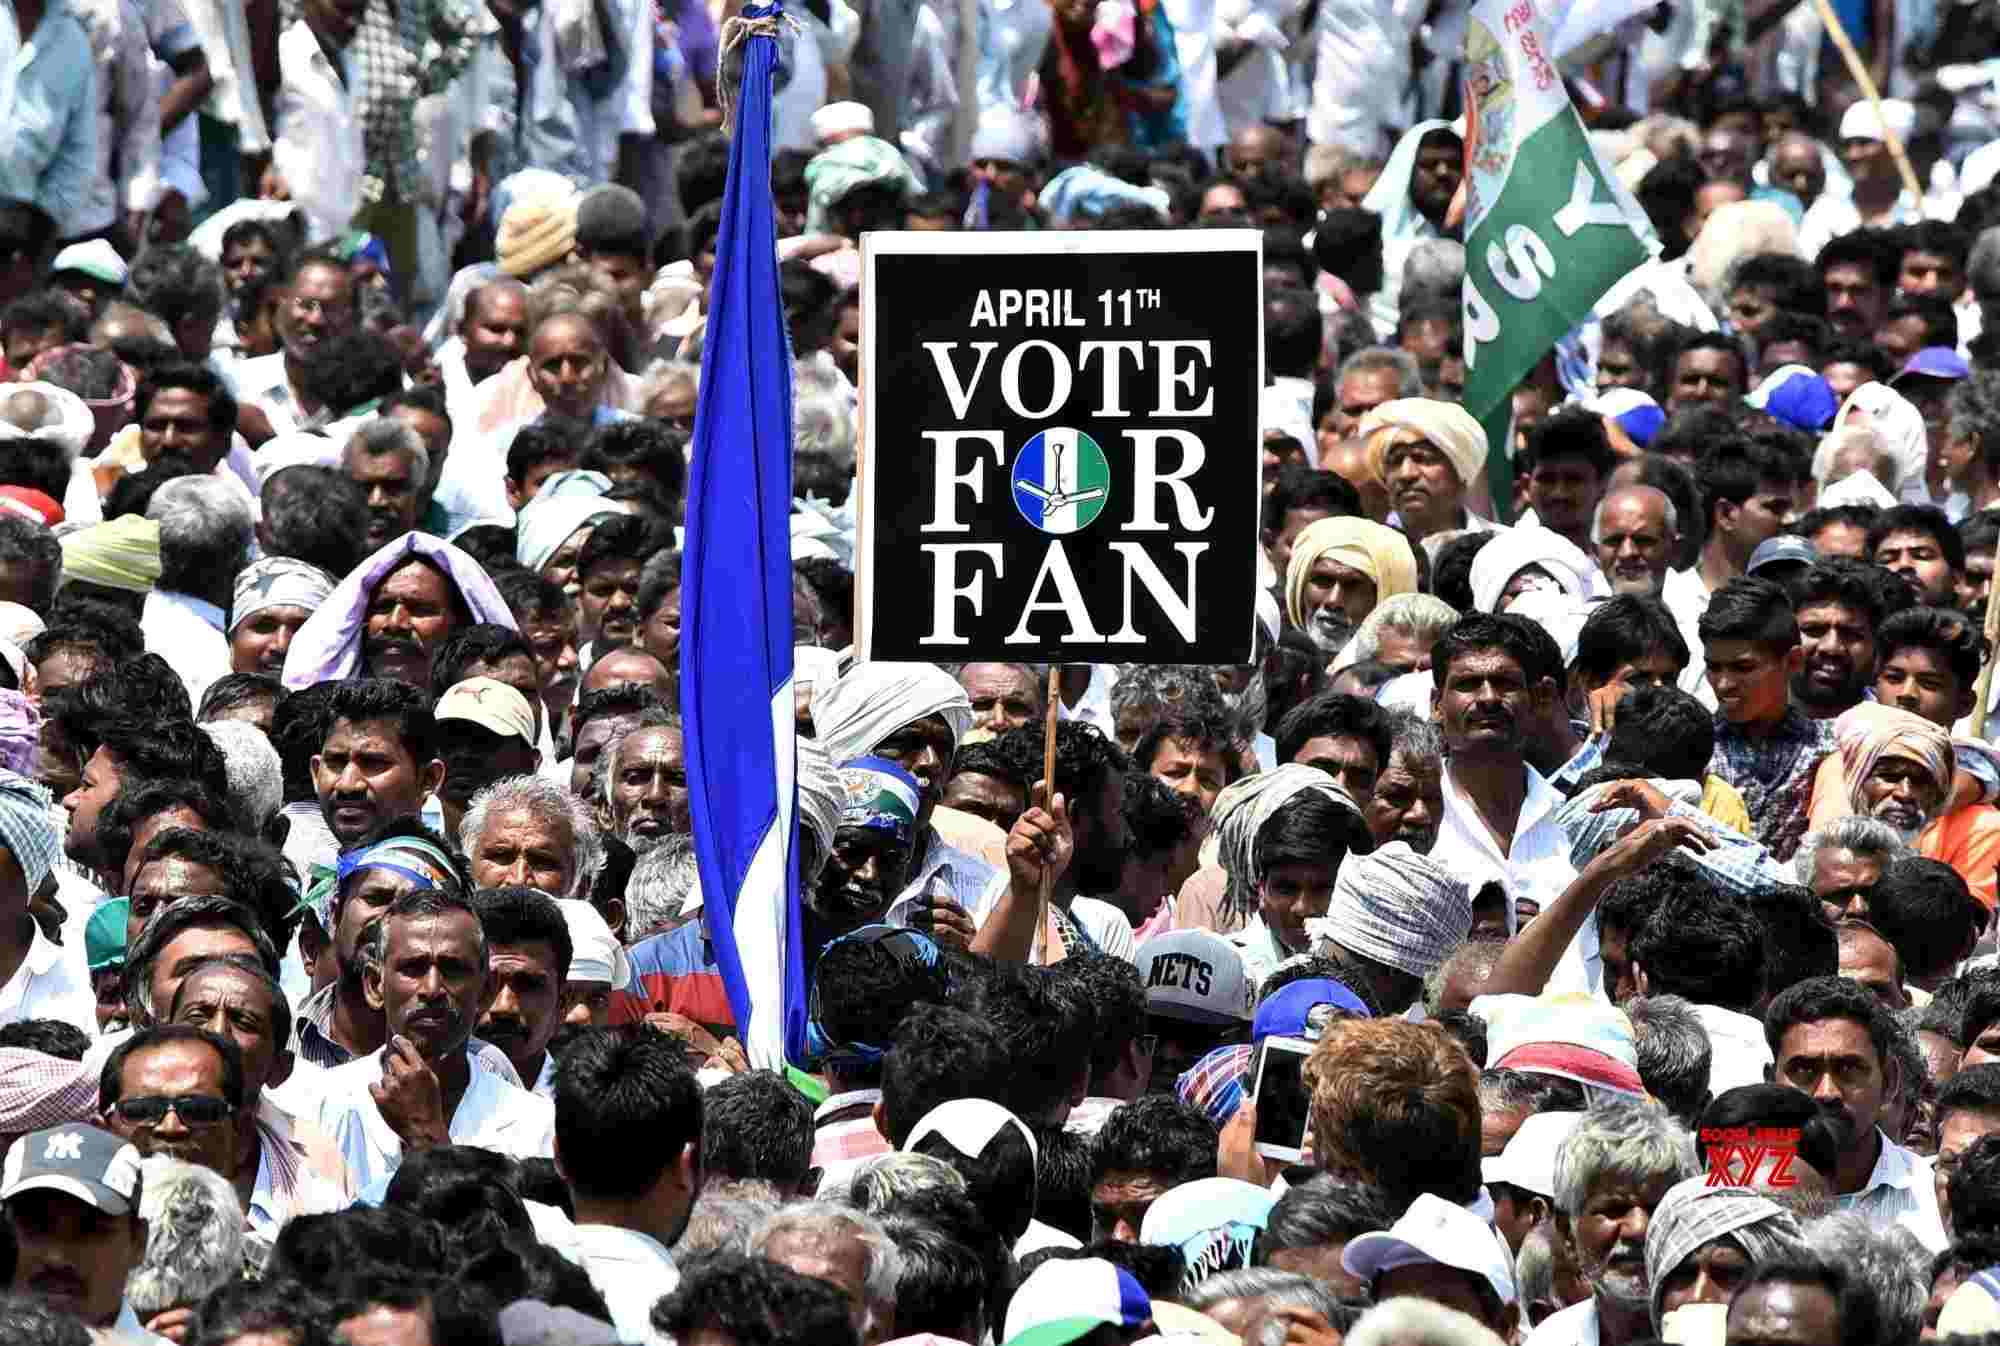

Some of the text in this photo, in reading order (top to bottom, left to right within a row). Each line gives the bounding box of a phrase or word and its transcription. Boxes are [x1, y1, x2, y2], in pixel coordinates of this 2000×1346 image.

[969, 288, 1161, 327] APRIL 11TH
[921, 339, 1215, 420] VOTE
[919, 539, 1211, 645] FAN
[1146, 952, 1213, 997] NETS
